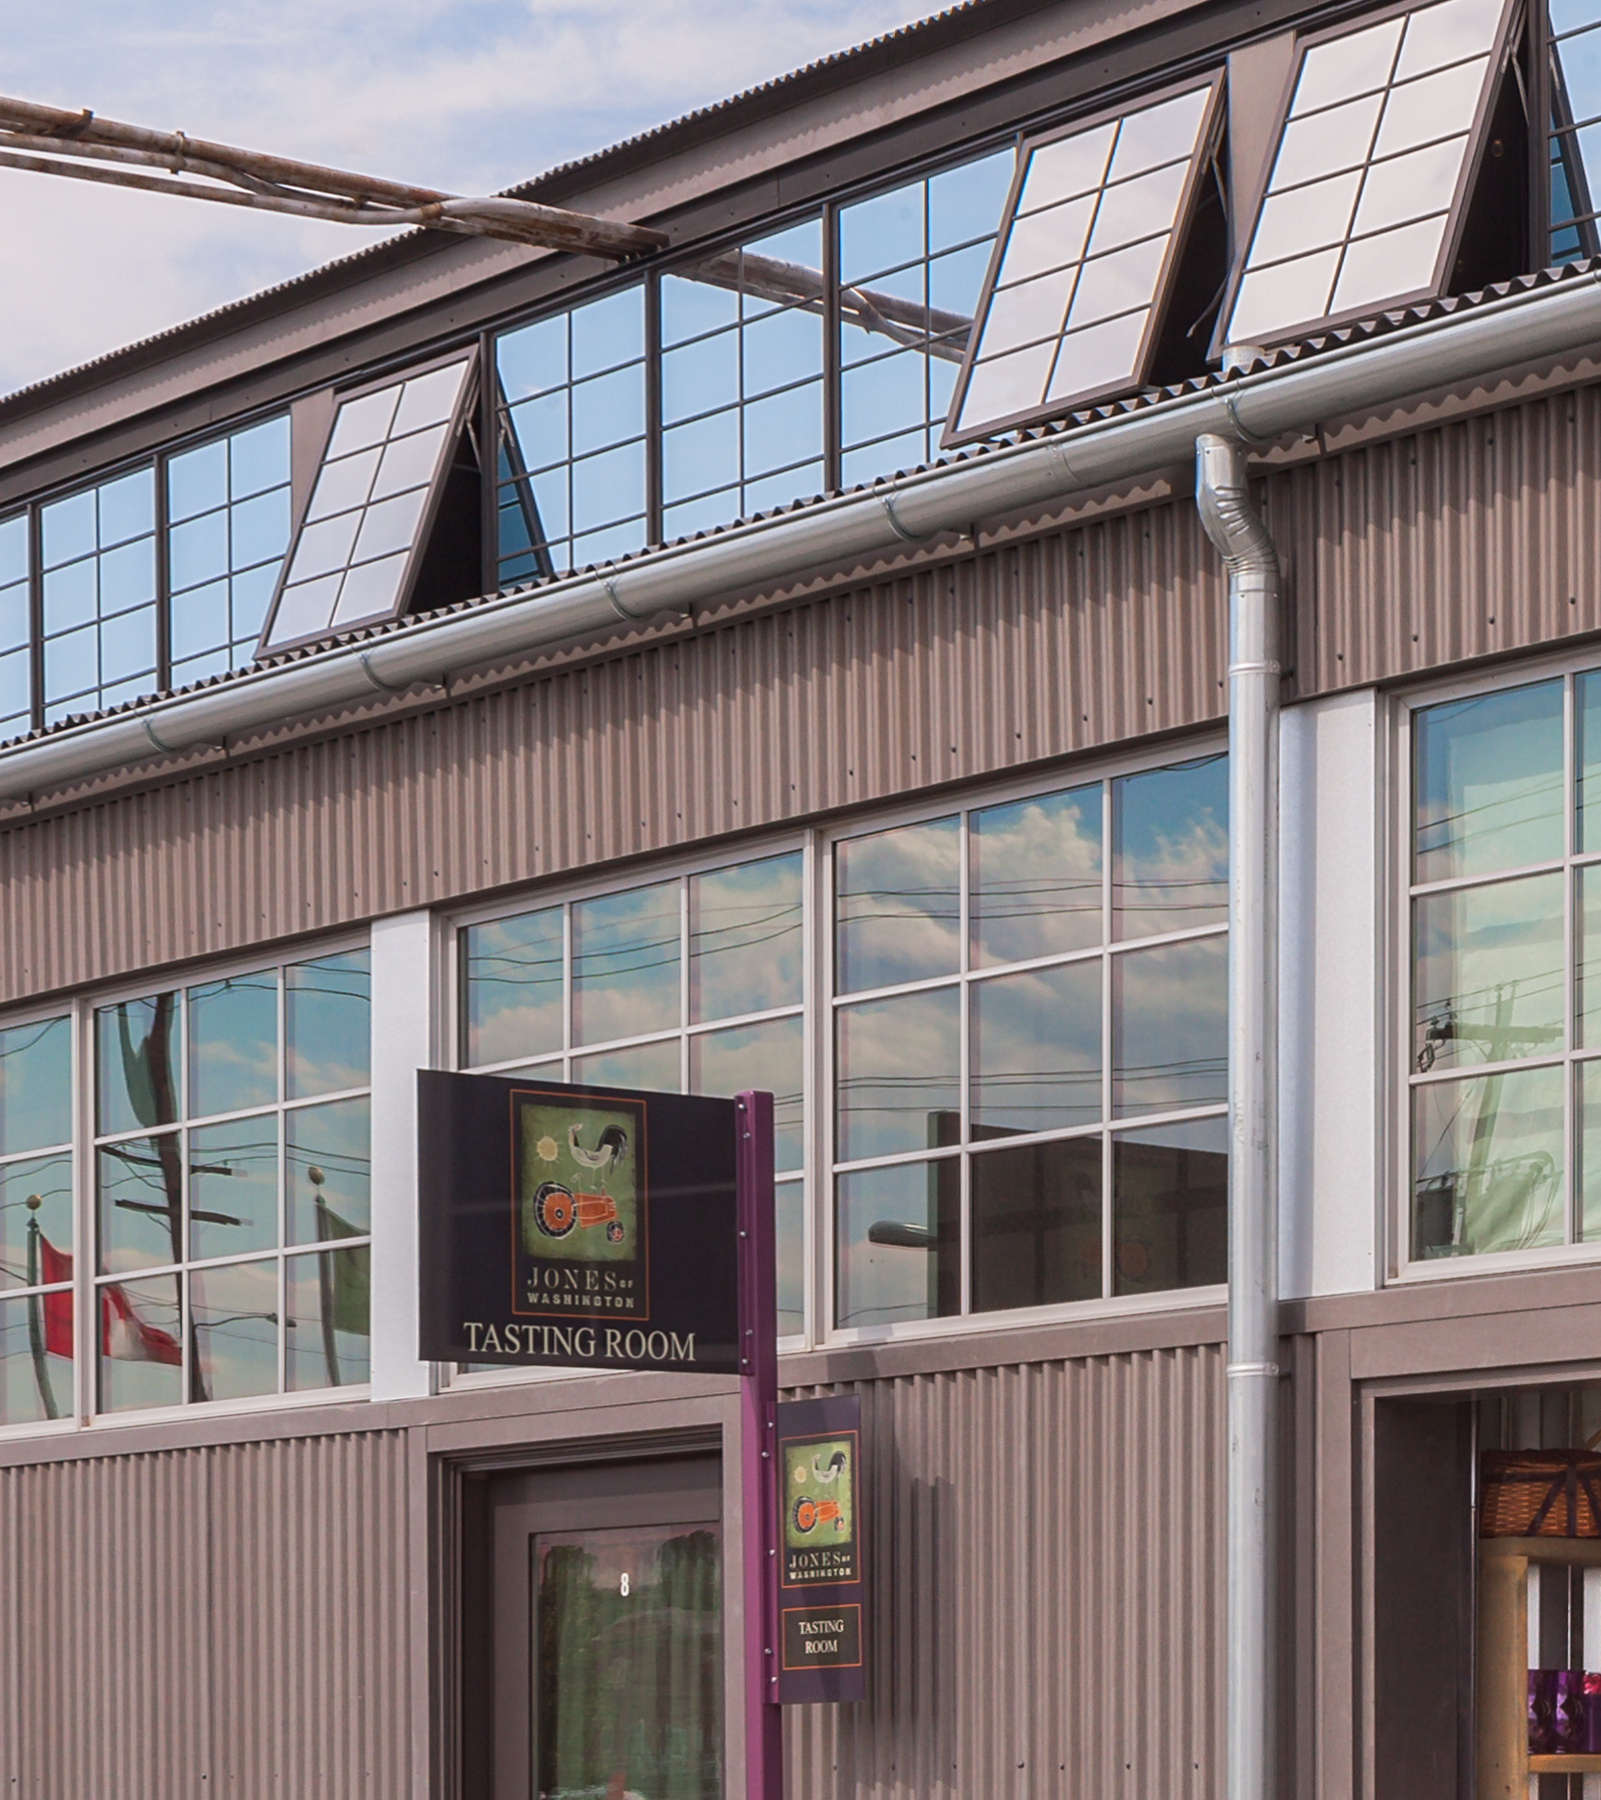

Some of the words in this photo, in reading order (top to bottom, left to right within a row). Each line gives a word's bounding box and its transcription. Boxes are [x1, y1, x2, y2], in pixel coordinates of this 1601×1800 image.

[527, 1267, 617, 1291] JONES
[619, 1279, 634, 1289] OF
[527, 1292, 635, 1309] WASHINGTON
[463, 1322, 597, 1357] TASTING
[604, 1328, 697, 1361] ROOM
[789, 1551, 841, 1569] JONES
[789, 1567, 852, 1580] WASHINGTON
[620, 1572, 630, 1597] 8
[798, 1619, 844, 1635] TASTING
[805, 1640, 838, 1654] ROOM
